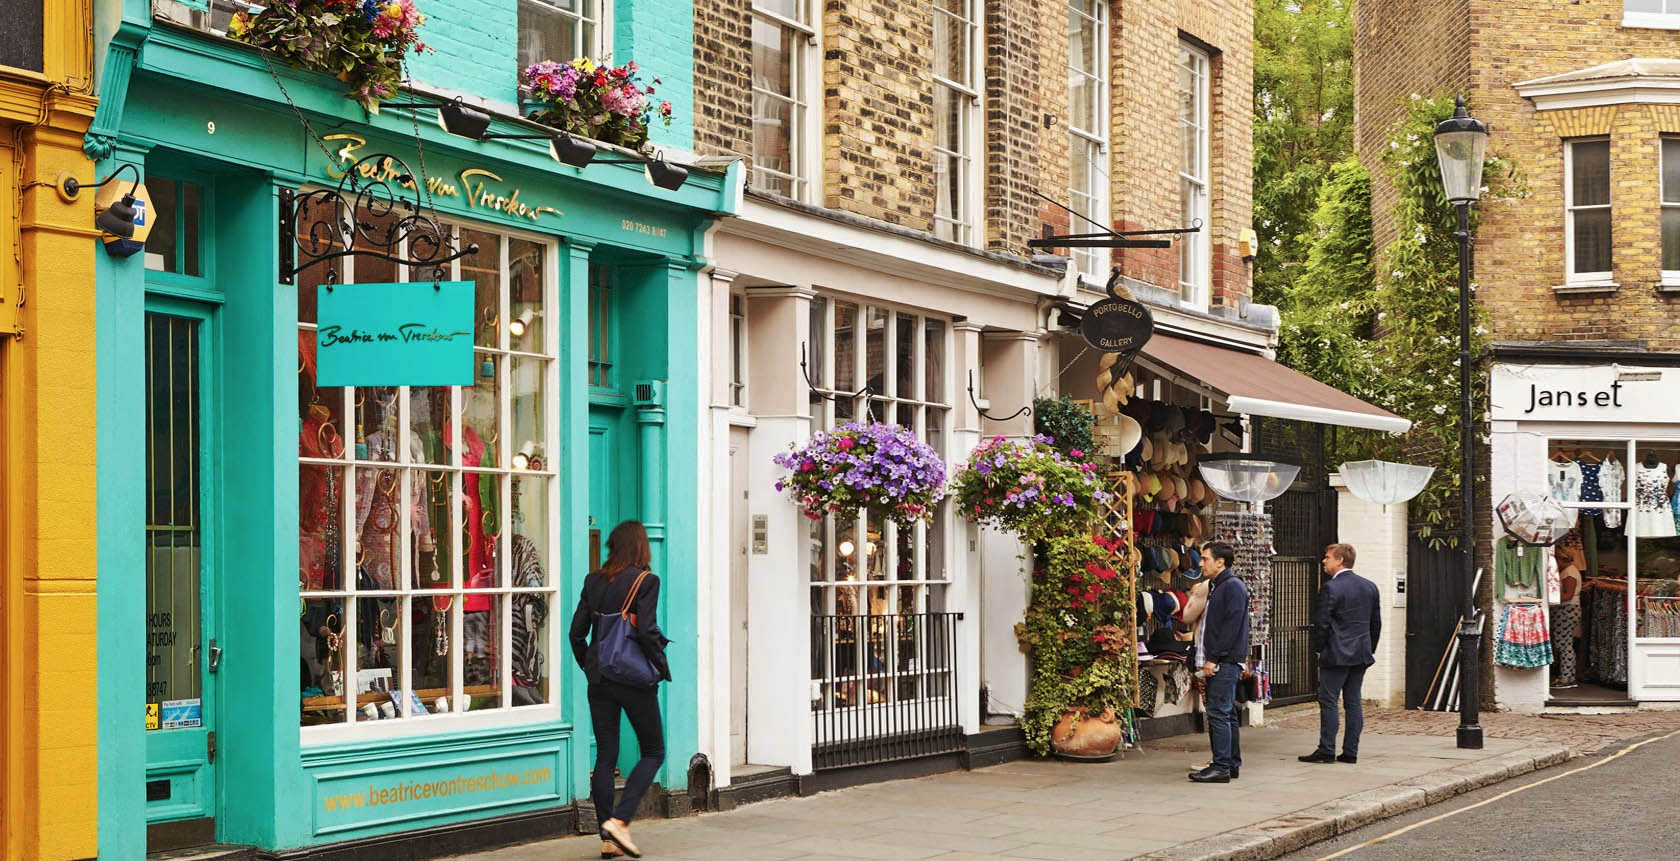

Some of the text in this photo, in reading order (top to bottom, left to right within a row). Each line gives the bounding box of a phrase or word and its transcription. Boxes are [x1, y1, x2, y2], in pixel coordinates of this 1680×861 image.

[207, 121, 215, 134] 9
[427, 176, 459, 197] von
[1093, 303, 1142, 319] PORTOBELLO
[1100, 337, 1133, 347] GALLERY
[1524, 380, 1622, 414] Janset
[146, 632, 177, 647] ATURDAY
[324, 767, 552, 813] www.beatricevontresckow.com
